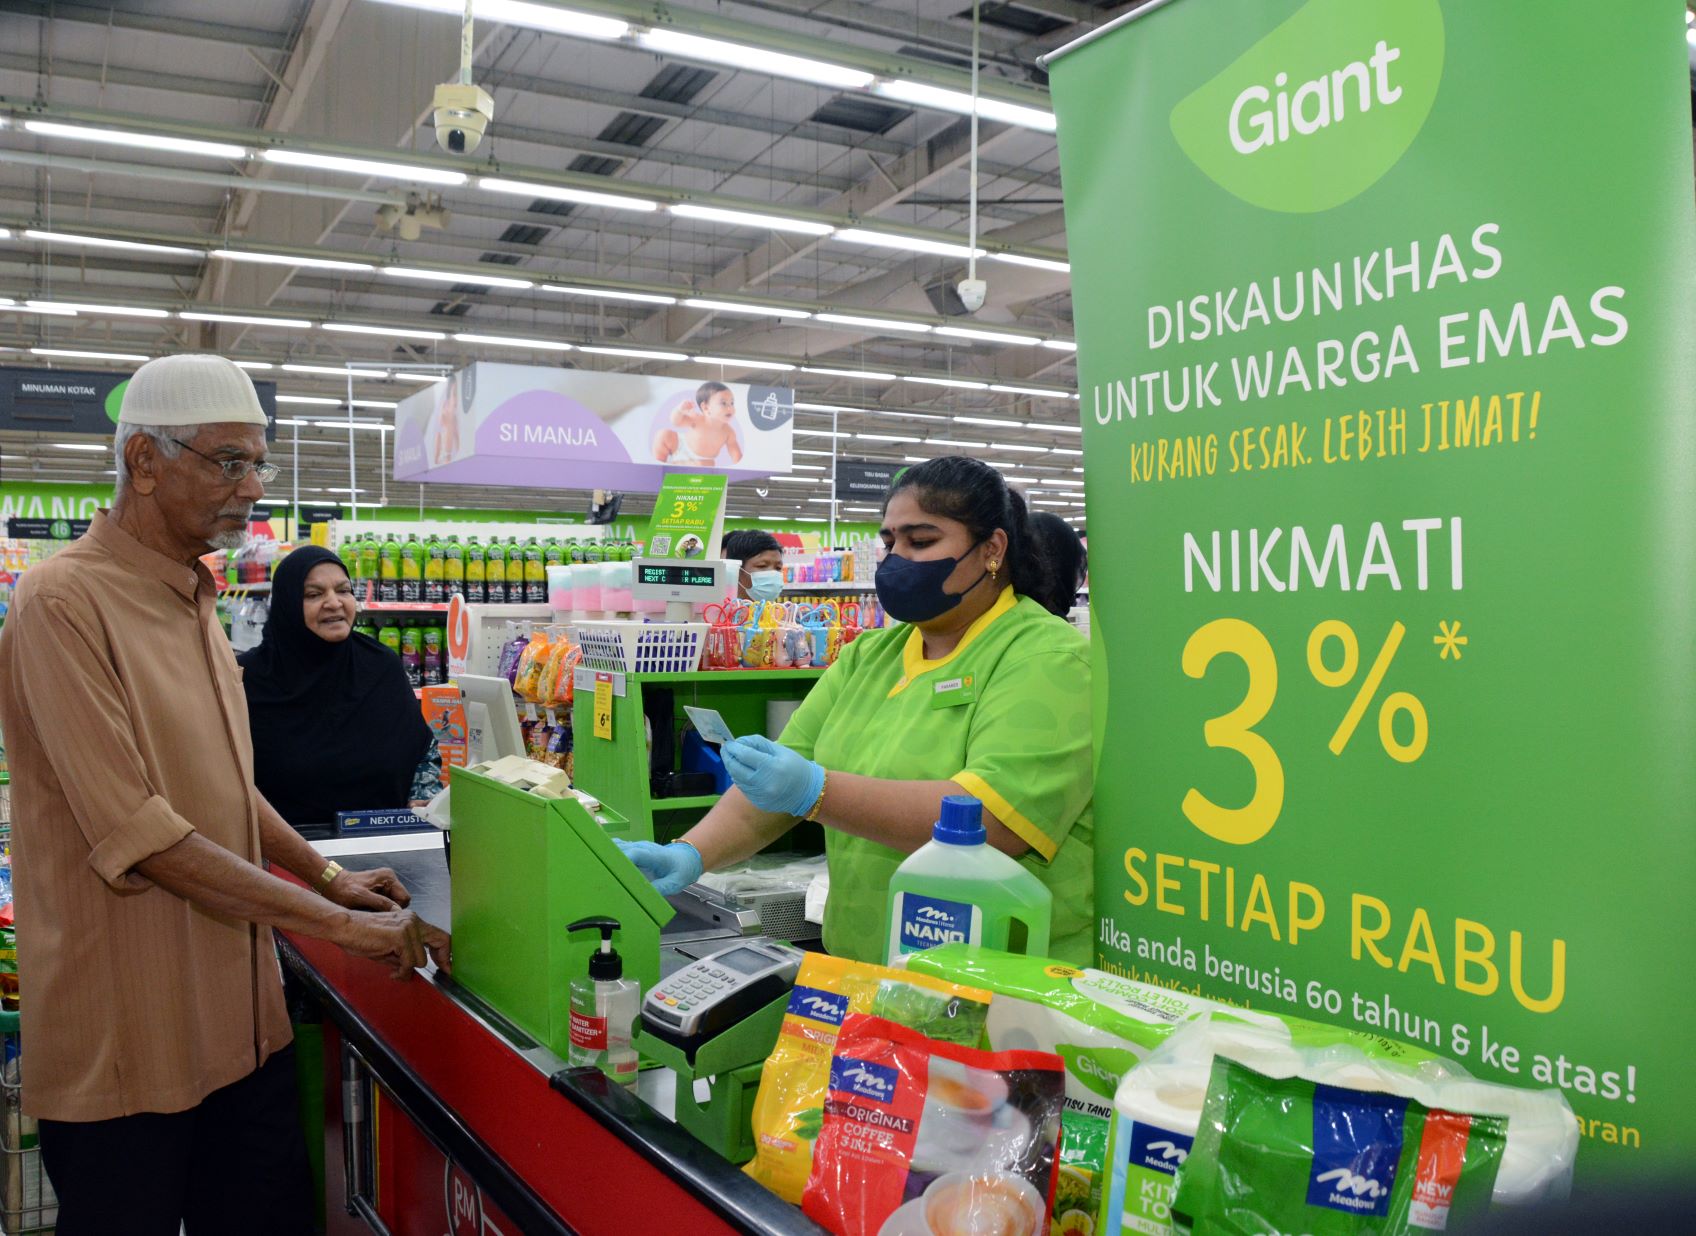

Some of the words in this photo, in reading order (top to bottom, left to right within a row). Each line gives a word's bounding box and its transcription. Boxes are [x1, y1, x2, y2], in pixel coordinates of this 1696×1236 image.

[1228, 40, 1403, 154] Giant
[1147, 262, 1344, 350] DISKAUN
[1353, 222, 1503, 306] KHAS
[1094, 361, 1222, 426] UNTUK
[1231, 324, 1420, 402] WARGA
[1438, 286, 1629, 369] EMAS
[22, 384, 66, 394] MINUMAN
[67, 386, 96, 396] KOTAK
[499, 423, 518, 443] SI
[524, 425, 598, 447] MANJA
[1130, 435, 1218, 484] KURANG
[1229, 424, 1312, 474] SESAK.
[1323, 406, 1407, 464] LEBIH
[1418, 391, 1542, 452] JIMAT!
[1183, 516, 1463, 592] NIKMATI
[369, 816, 395, 825] NEXT
[904, 921, 965, 944] NANO
[1123, 847, 1325, 946] SETIAP
[1351, 893, 1567, 1013] RABU
[1099, 917, 1131, 953] Jika
[1137, 936, 1197, 972] anda
[1205, 944, 1298, 1003] berusia
[1305, 983, 1342, 1015] 60
[1352, 990, 1441, 1047] tahun
[1451, 1024, 1471, 1057] &
[1481, 1025, 1521, 1073] ke
[1531, 1057, 1638, 1103] atas!
[1077, 1055, 1120, 1087] Gian
[1064, 1096, 1085, 1110] TISU
[847, 1105, 909, 1132] ORIGINAL
[843, 1122, 894, 1145] COFFEE
[1329, 1193, 1375, 1210] Meadows
[1416, 1180, 1452, 1197] NEW
